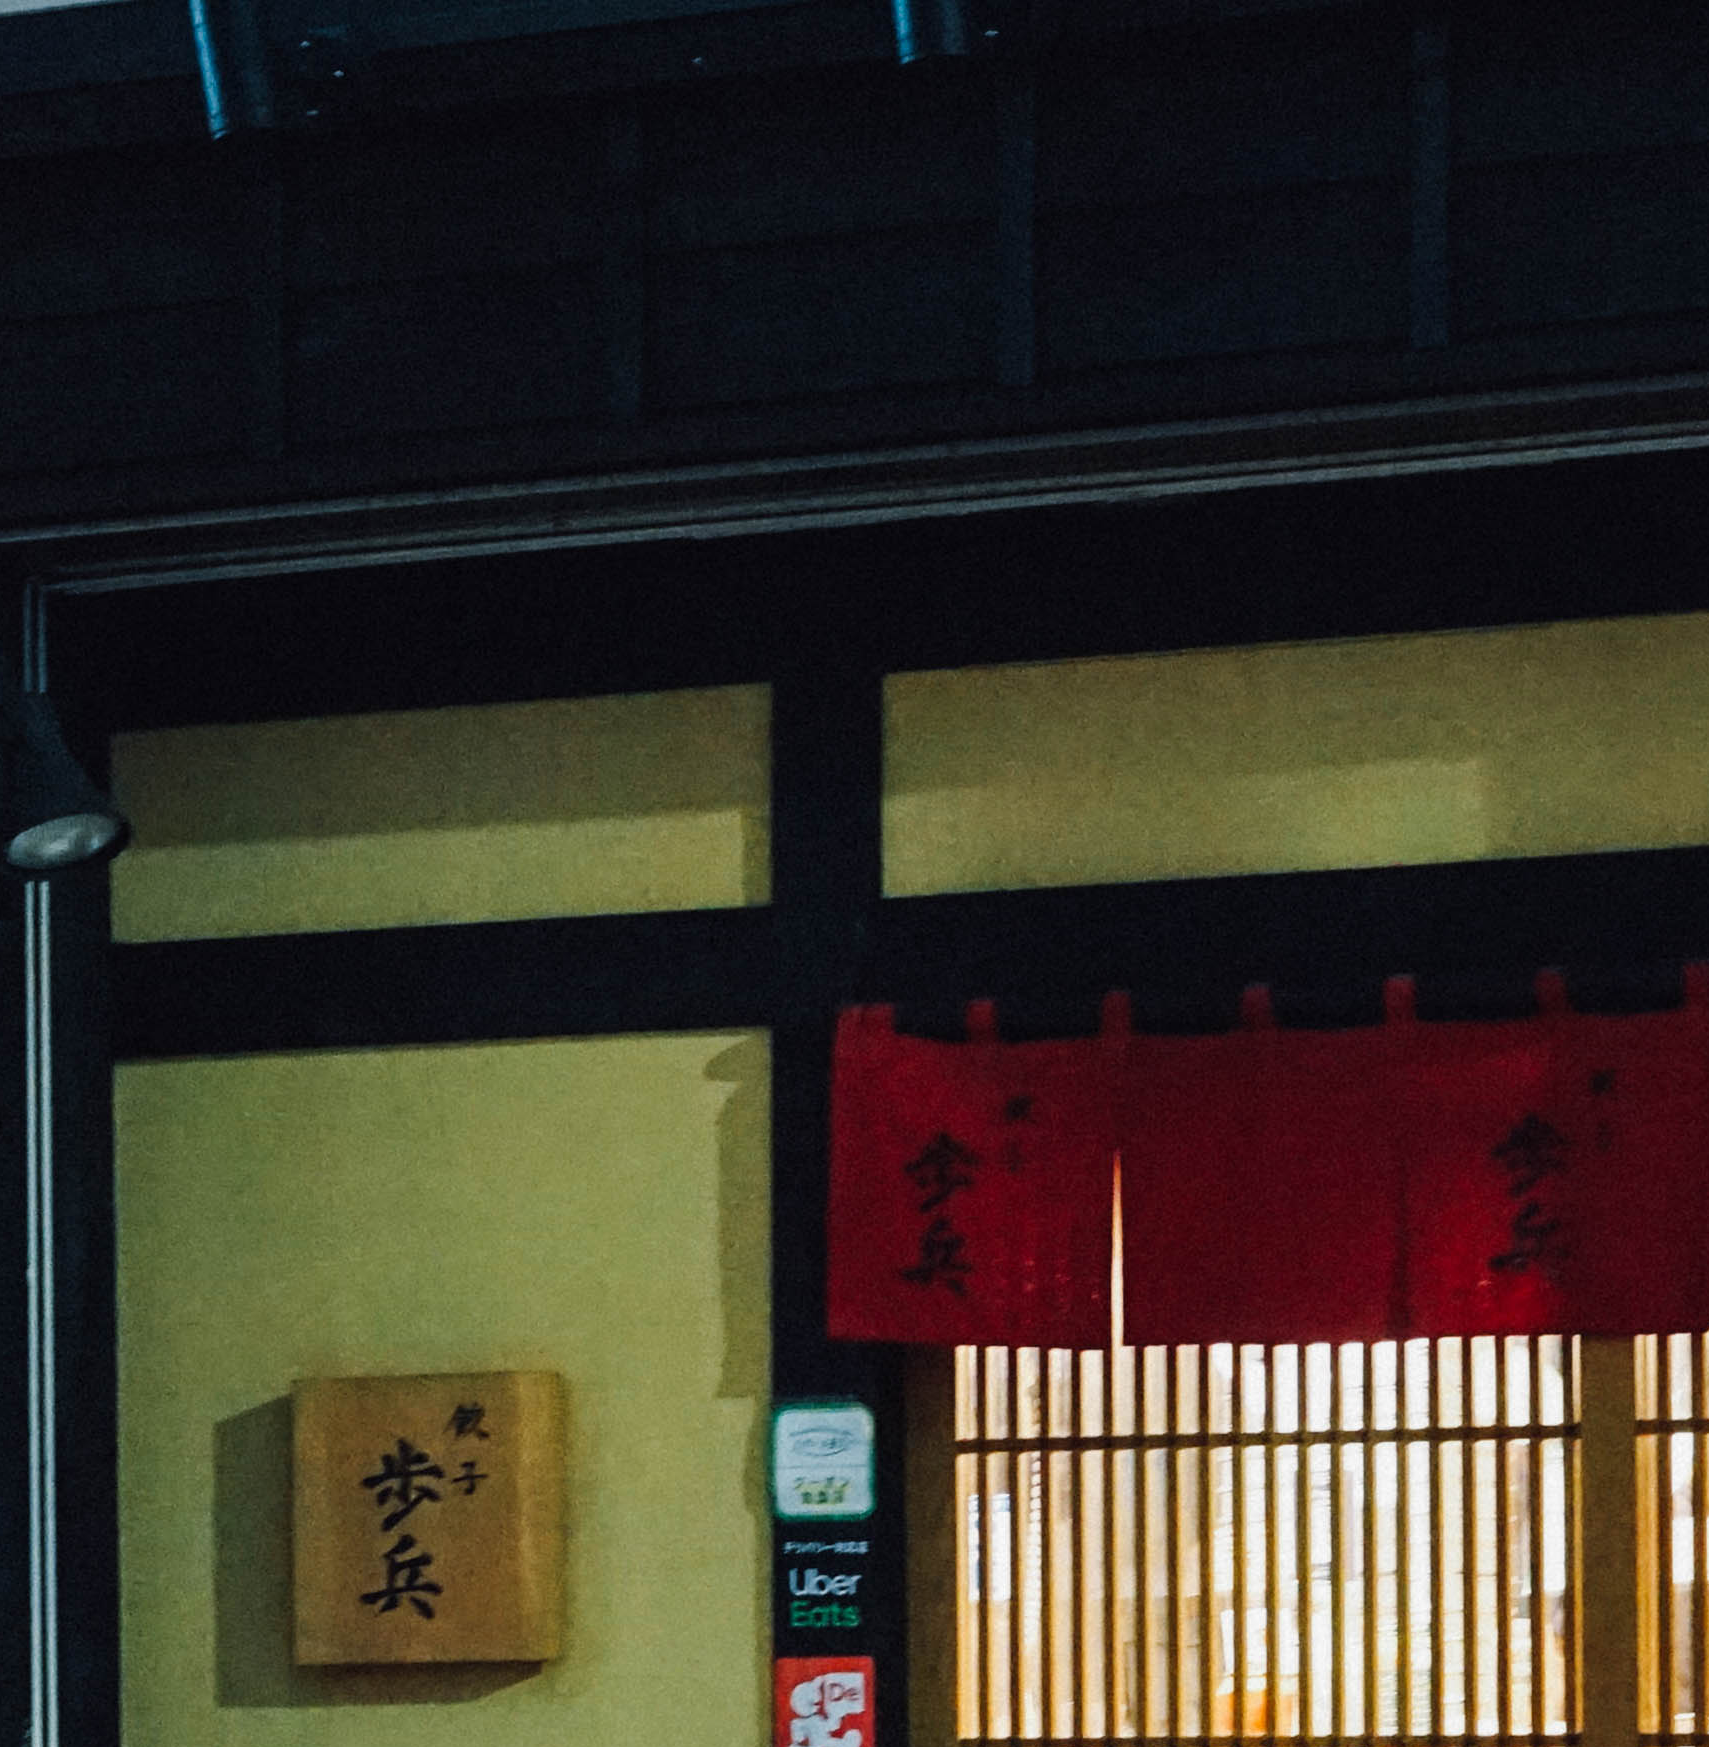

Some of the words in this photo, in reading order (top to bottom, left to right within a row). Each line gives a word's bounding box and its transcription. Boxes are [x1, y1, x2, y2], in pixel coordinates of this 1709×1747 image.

[357, 1436, 445, 1621] 歩兵
[789, 1568, 863, 1597] Uber
[791, 1602, 861, 1629] Eats
